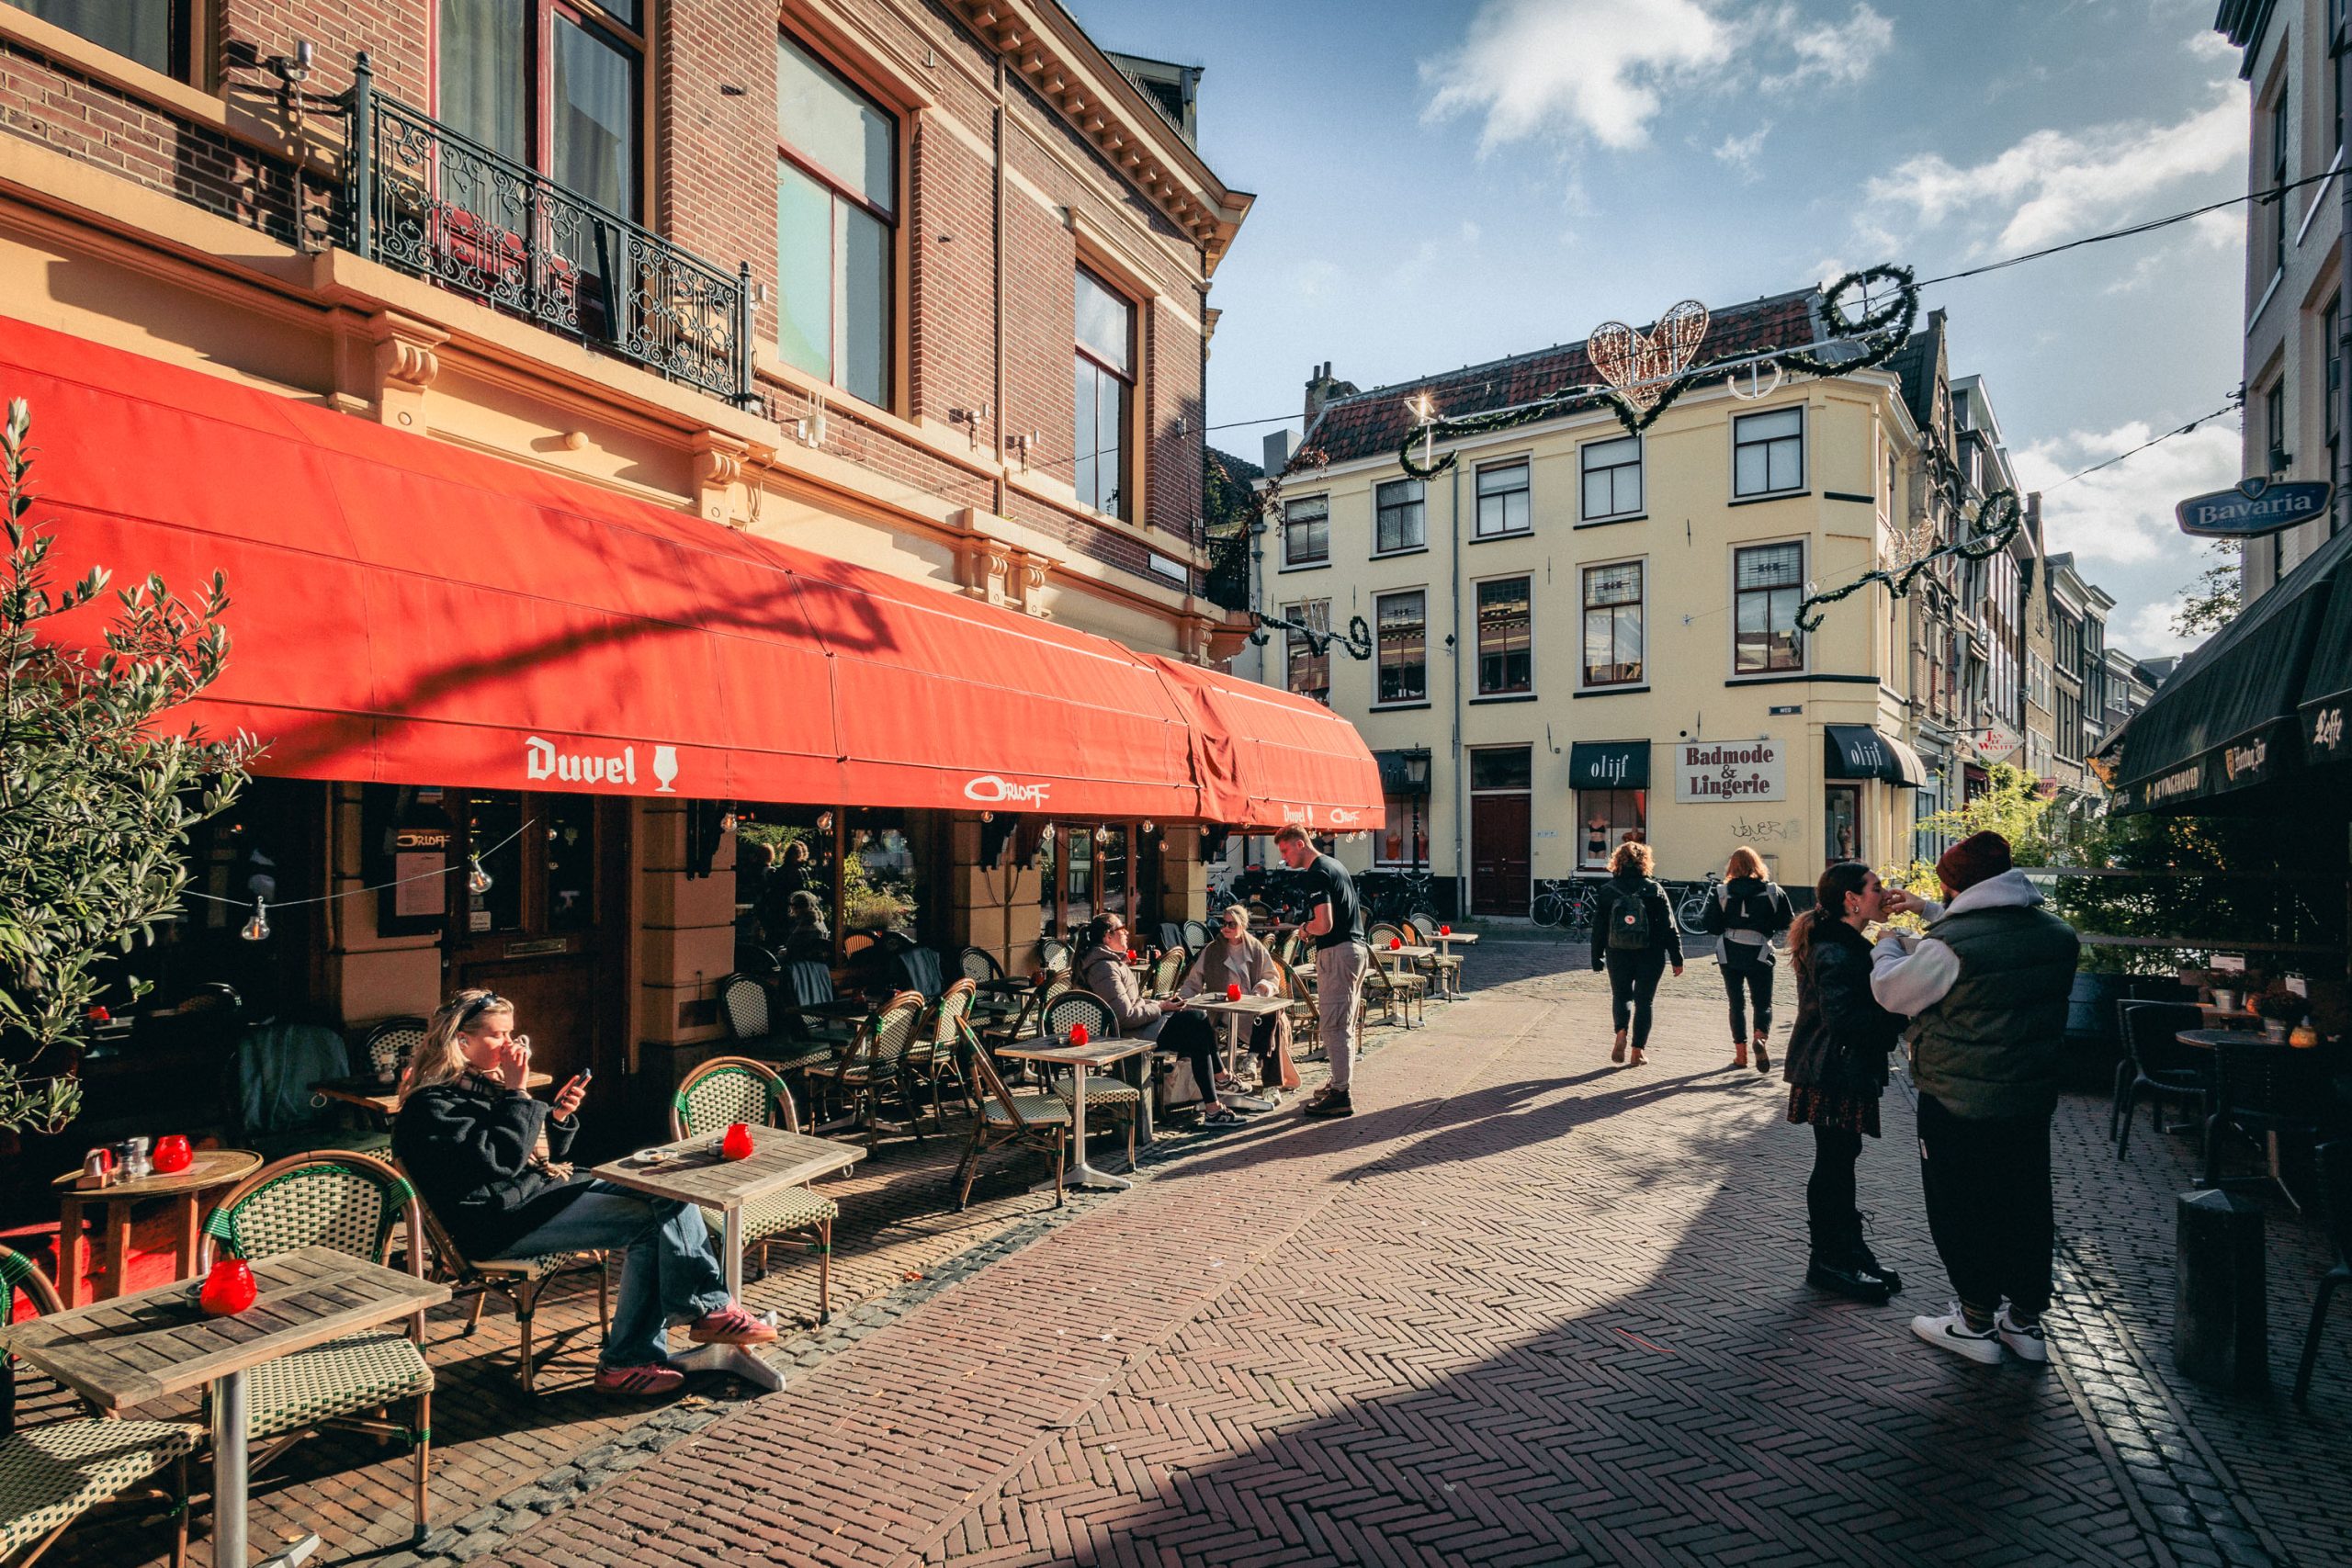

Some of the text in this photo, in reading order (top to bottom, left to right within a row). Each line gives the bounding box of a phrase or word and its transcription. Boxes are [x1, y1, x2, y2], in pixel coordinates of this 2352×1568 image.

[2198, 493, 2312, 525] Bavaria
[525, 736, 637, 785] Duvel
[1590, 755, 1629, 787] olijf
[1686, 745, 1774, 766] Badmode
[1850, 742, 1883, 776] olijf
[1690, 775, 1770, 799] Lingerie
[1721, 765, 1736, 779] &
